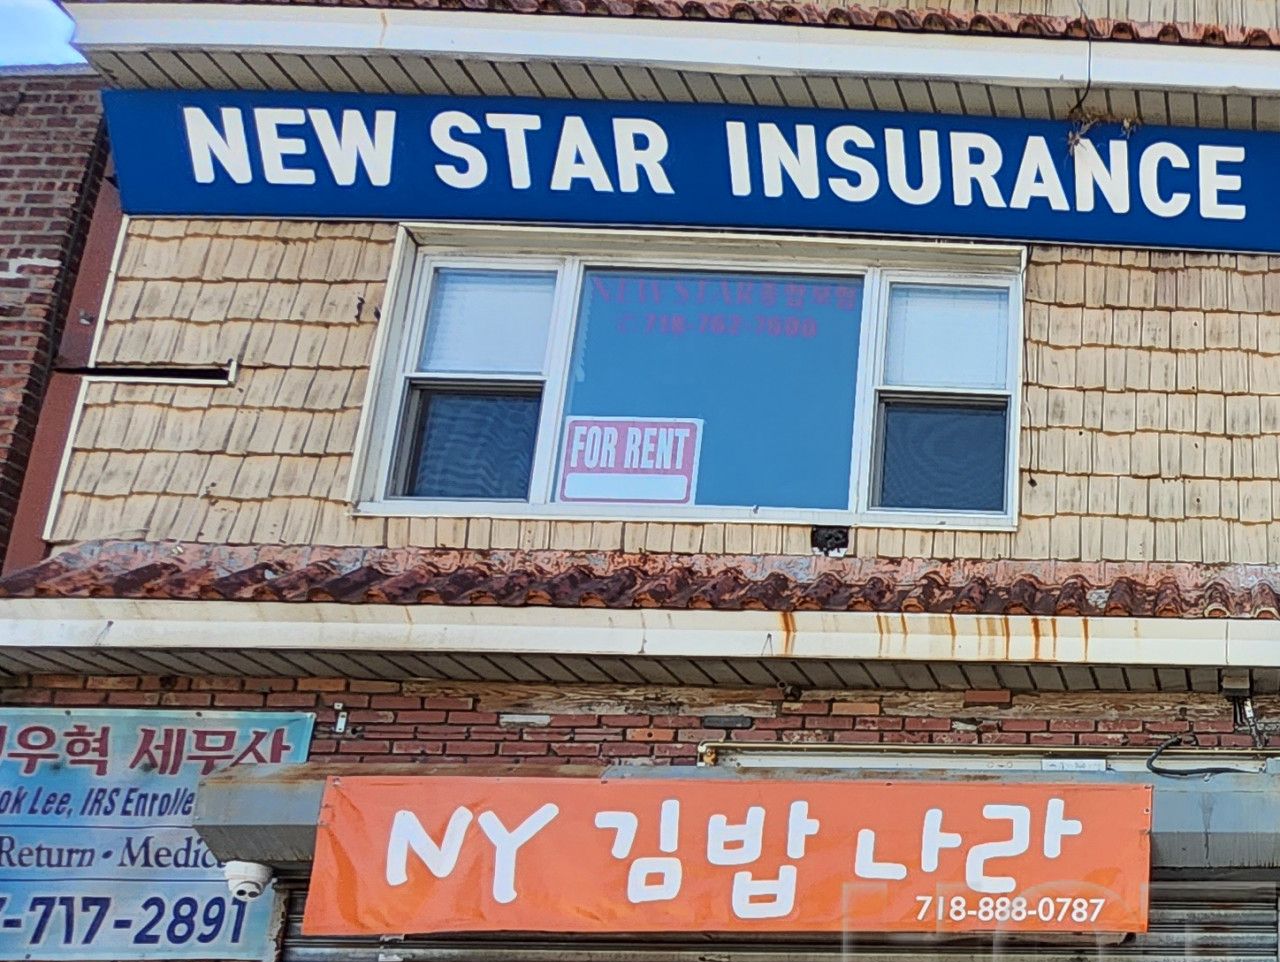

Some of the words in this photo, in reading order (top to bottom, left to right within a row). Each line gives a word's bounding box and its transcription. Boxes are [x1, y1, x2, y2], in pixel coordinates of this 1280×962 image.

[182, 106, 397, 187] NEW
[429, 111, 676, 194] STAR
[724, 120, 1247, 221] INSURANCE
[570, 425, 619, 469] FOR
[623, 426, 691, 470] RENT
[129, 727, 292, 776] 세무사
[28, 786, 72, 818] Lee,
[80, 787, 120, 816] IRS
[0, 835, 95, 868] Return
[117, 836, 228, 870] Medic
[385, 801, 561, 904] NY
[594, 799, 820, 919] 김밥
[855, 798, 1083, 893] 나라
[0, 896, 250, 945] -717-2891
[915, 894, 1107, 923] 718-888-0787
